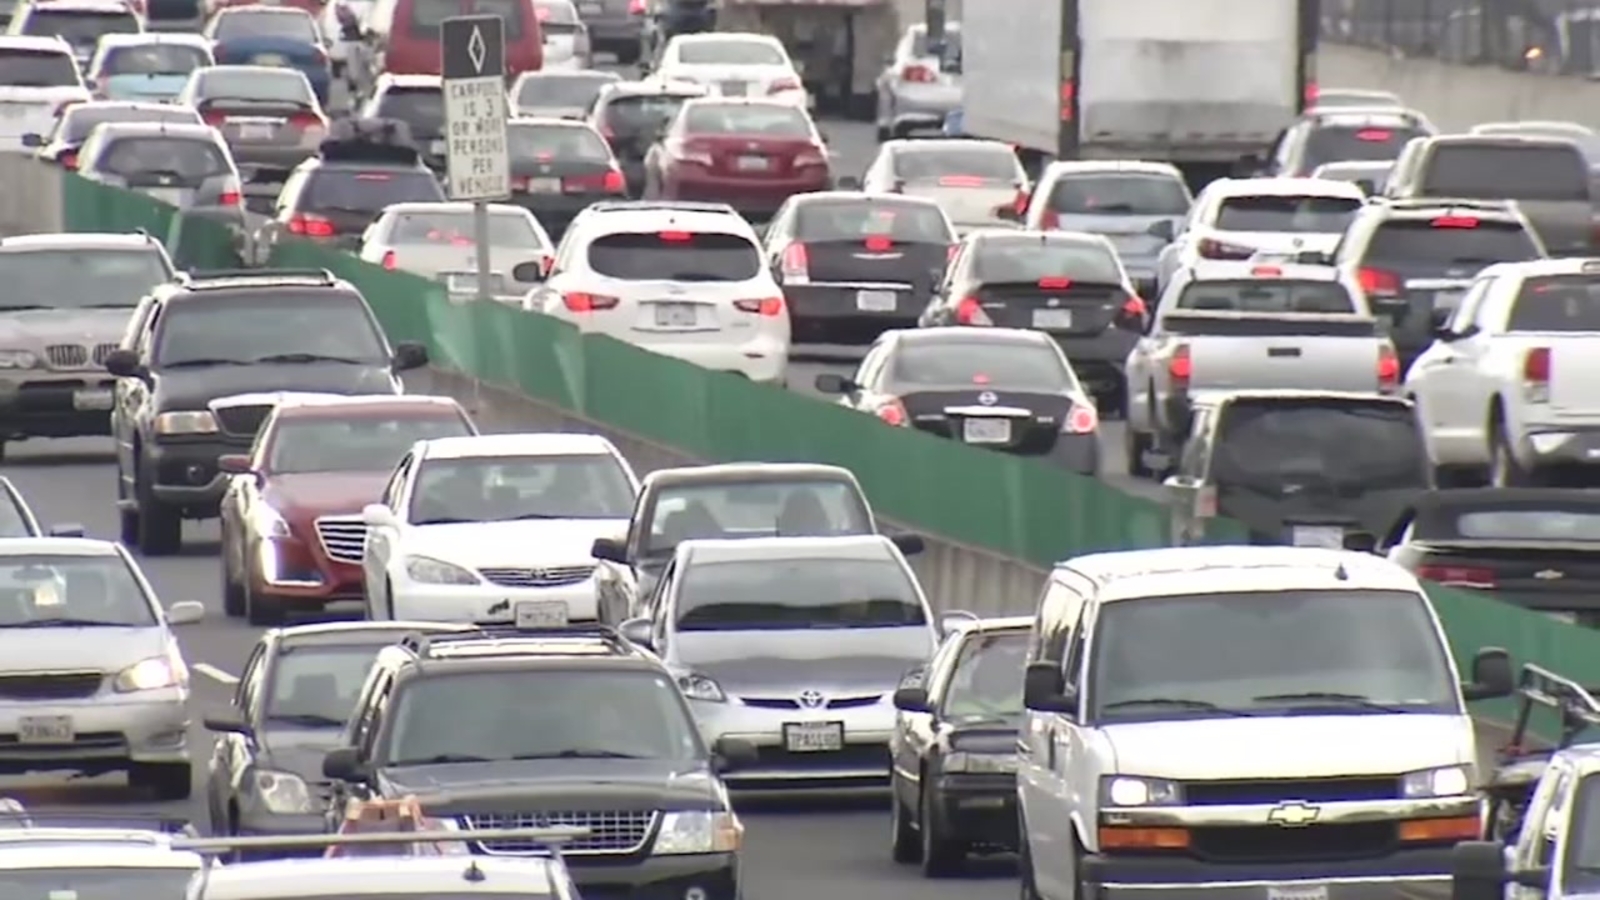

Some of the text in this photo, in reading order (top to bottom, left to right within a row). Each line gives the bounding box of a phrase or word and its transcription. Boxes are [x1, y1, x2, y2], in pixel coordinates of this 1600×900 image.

[450, 82, 499, 99] CARPOOL
[463, 98, 494, 117] IS 3
[452, 121, 470, 136] OR
[453, 137, 503, 156] PERSONS
[472, 158, 492, 174] PER
[459, 176, 503, 194] VEHICLE
